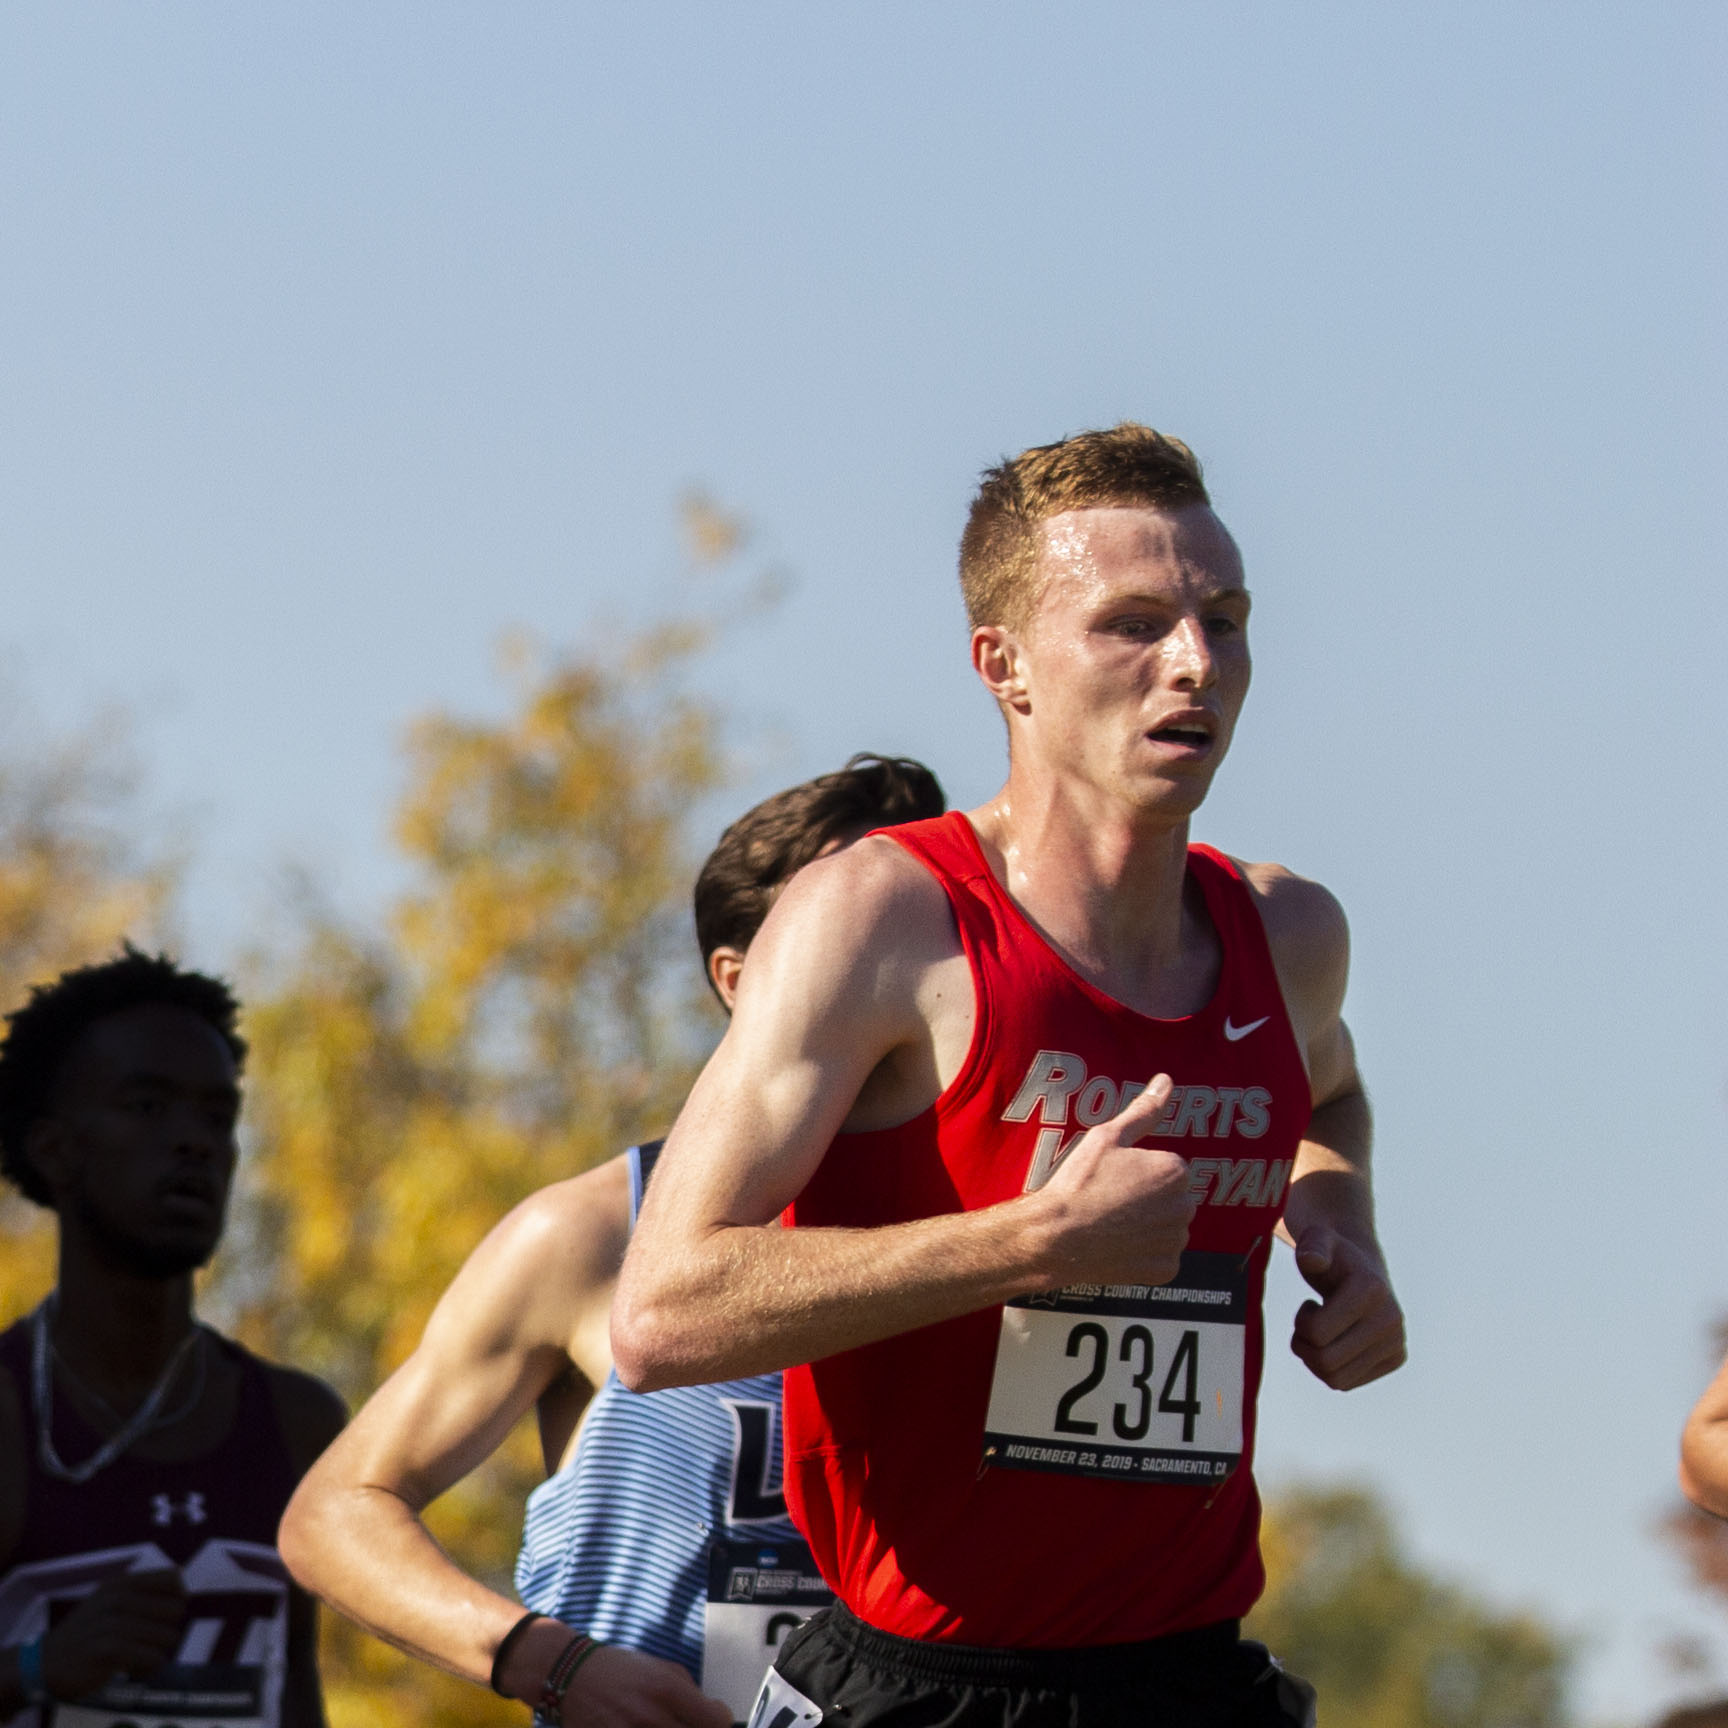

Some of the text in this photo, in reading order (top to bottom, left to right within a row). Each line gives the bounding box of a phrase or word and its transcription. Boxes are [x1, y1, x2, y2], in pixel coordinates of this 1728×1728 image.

[1104, 1285, 1150, 1300] COUNTRY
[1151, 1286, 1232, 1305] CHAMPIONSHIPS
[1054, 1322, 1201, 1442] 234
[1006, 1444, 1075, 1464] NOVEMBER
[1102, 1455, 1133, 1470] 2019
